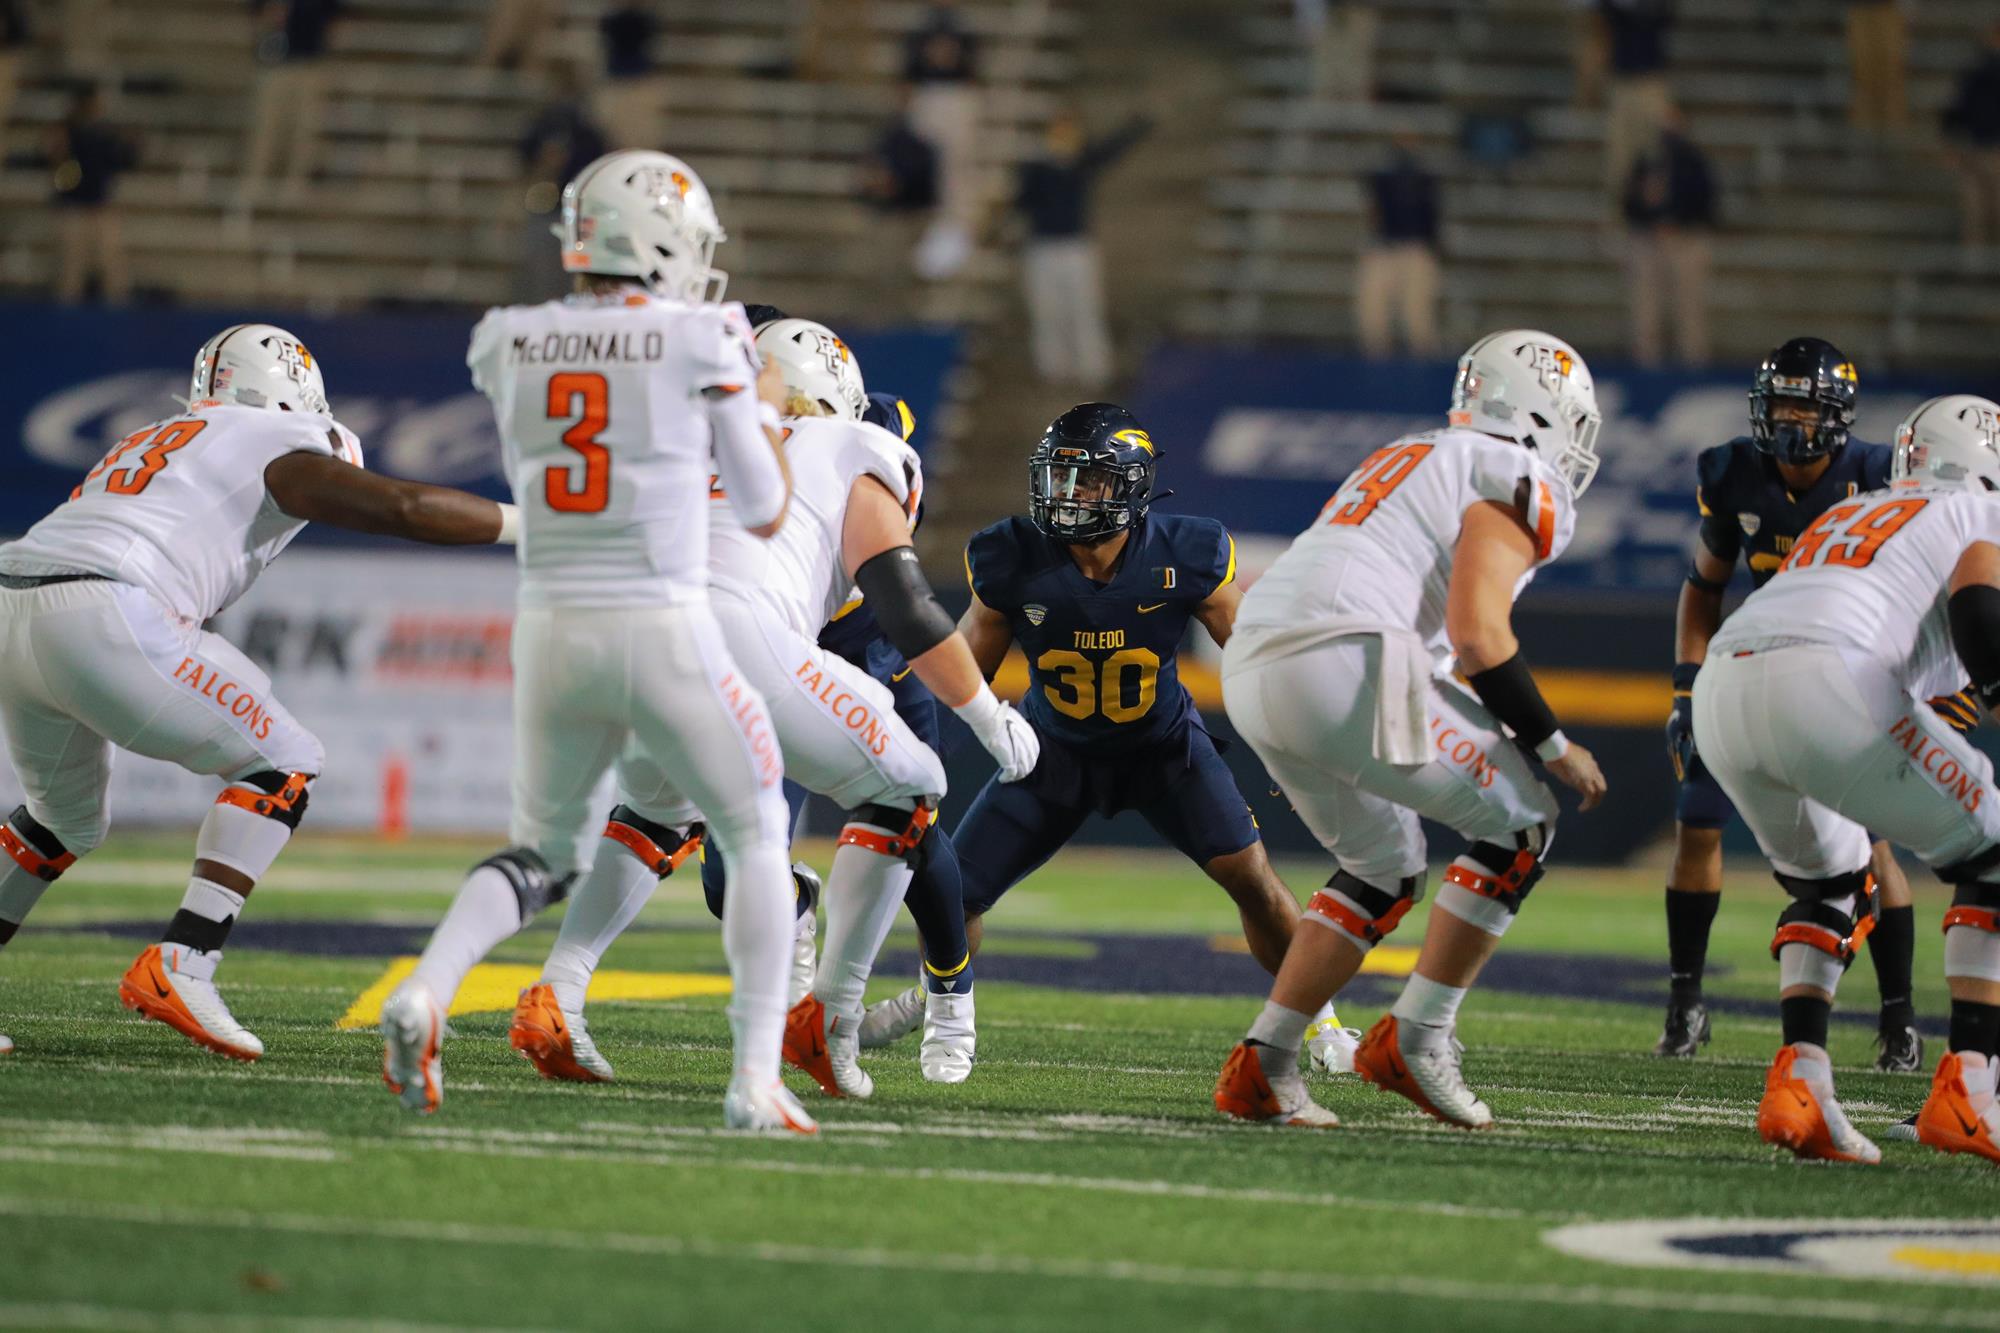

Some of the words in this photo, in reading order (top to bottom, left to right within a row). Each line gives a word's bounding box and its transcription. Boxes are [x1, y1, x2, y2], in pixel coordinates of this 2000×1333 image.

[511, 332, 663, 365] McDONALD
[546, 373, 610, 513] 3
[1778, 498, 1929, 574] 69
[1074, 629, 1125, 649] TOLEDO
[173, 657, 273, 740] FALCONS
[796, 660, 890, 755] FALCONS
[1038, 647, 1160, 724] 30
[1889, 716, 1984, 814] FALCONS
